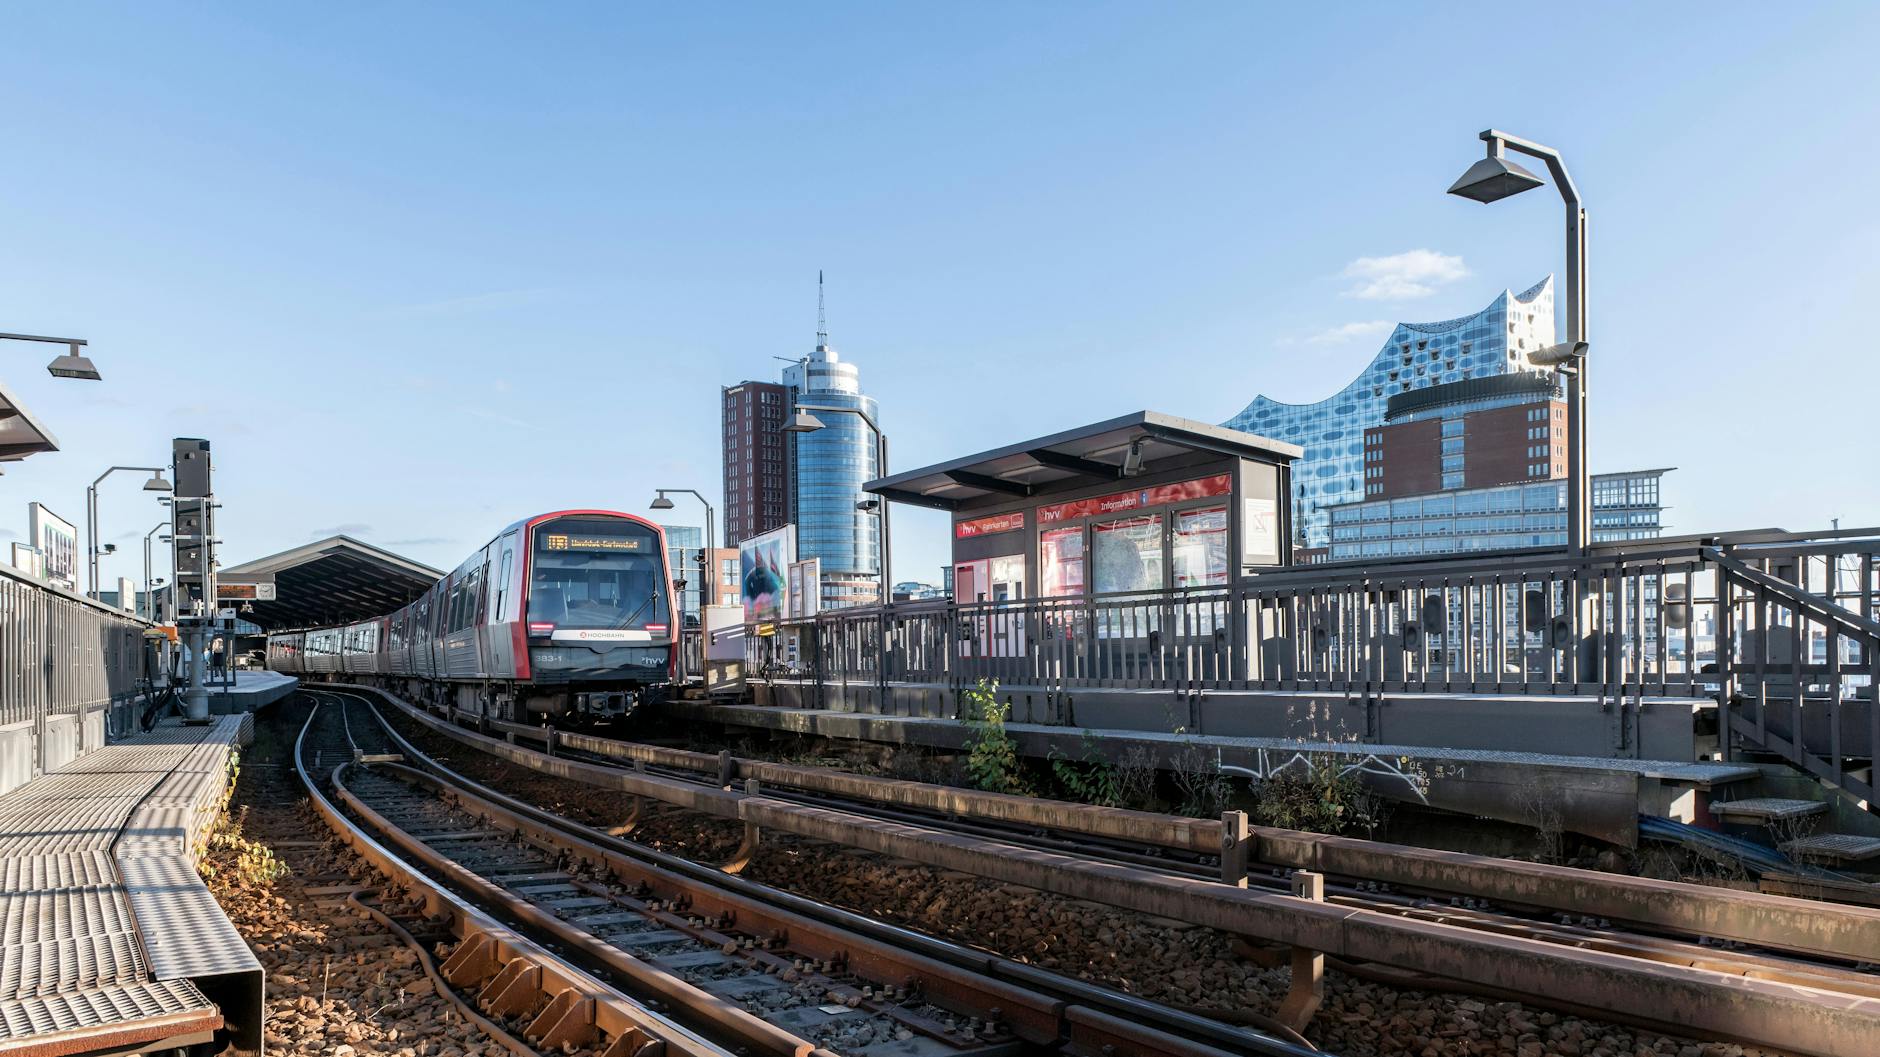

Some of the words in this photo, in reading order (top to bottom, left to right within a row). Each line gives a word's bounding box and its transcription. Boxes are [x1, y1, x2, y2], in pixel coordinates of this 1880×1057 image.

[1044, 509, 1061, 520] hvv
[1100, 497, 1137, 512] Information
[962, 523, 976, 535] hvv
[645, 656, 665, 665] hvv
